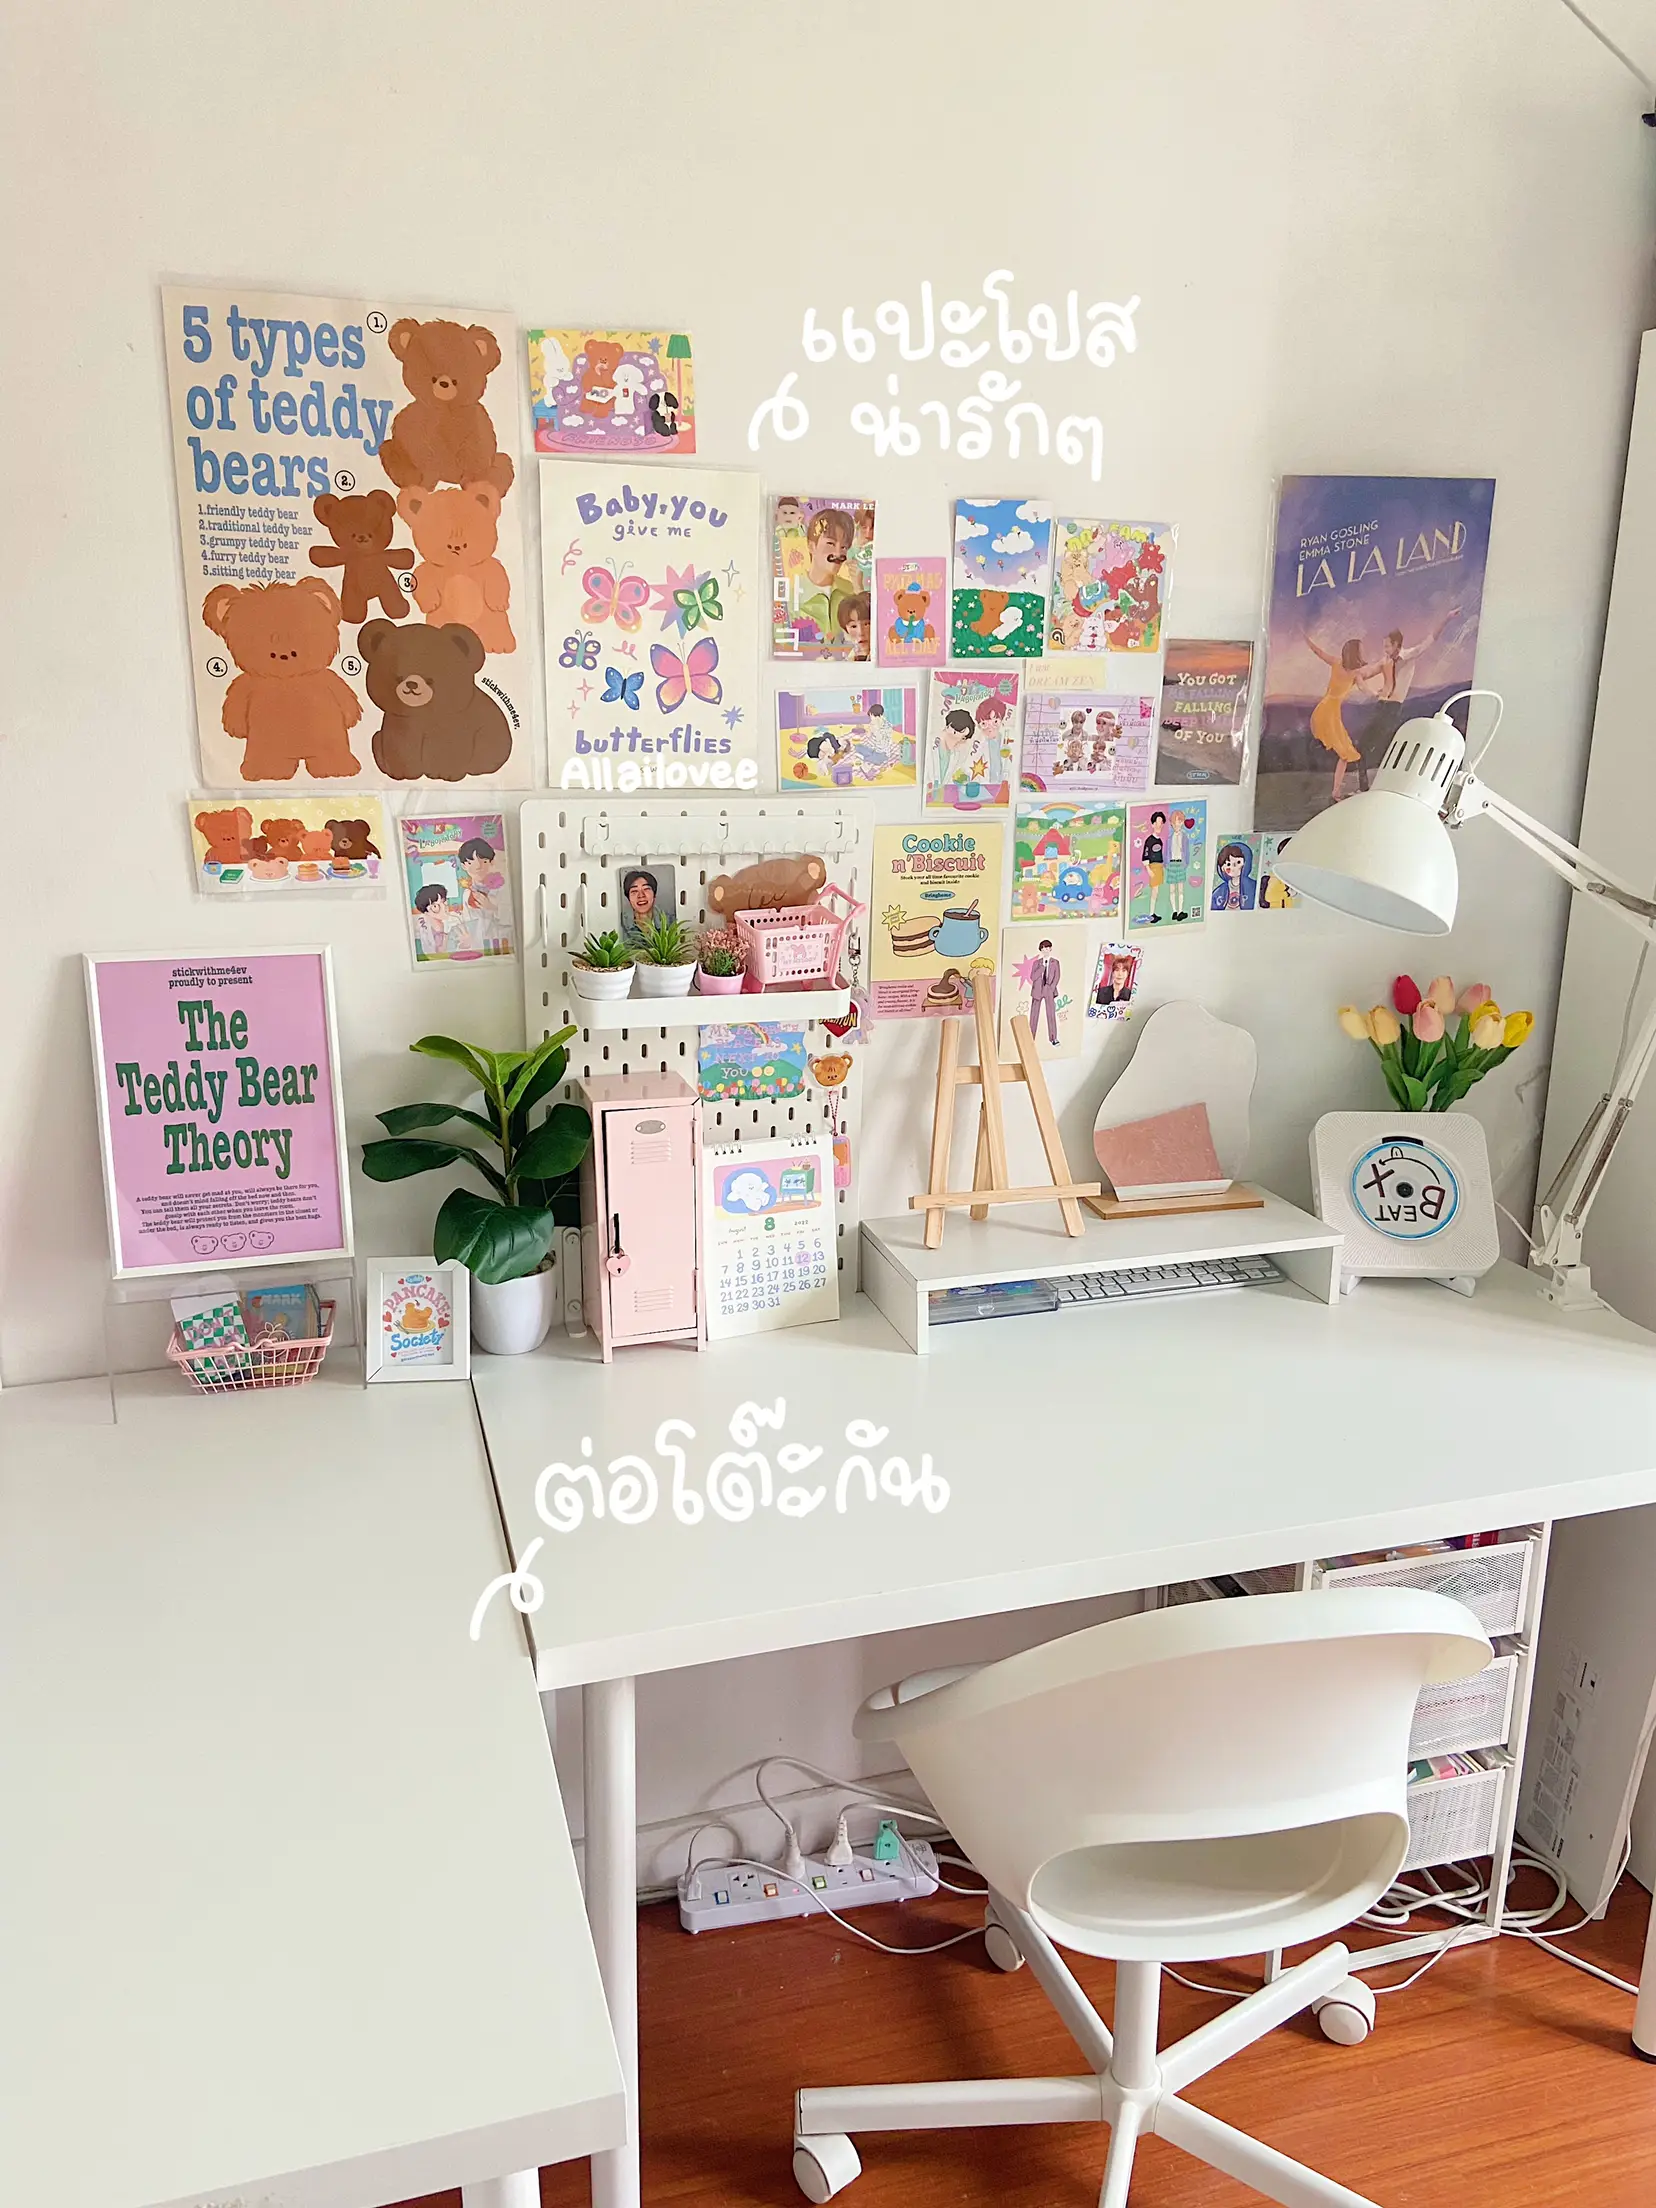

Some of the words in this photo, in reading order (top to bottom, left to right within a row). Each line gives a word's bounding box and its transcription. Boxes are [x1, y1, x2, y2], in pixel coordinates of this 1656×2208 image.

[183, 305, 212, 363] 5
[227, 305, 366, 378] types
[187, 374, 238, 431] of
[248, 378, 394, 456] teddy
[187, 436, 331, 498] bears
[248, 507, 276, 521] teddy
[277, 508, 299, 520] bear
[831, 502, 860, 510] MARK
[262, 522, 290, 537] teddy
[292, 524, 313, 536] bear
[1300, 532, 1328, 549] RYAN
[1330, 519, 1379, 540] GOSLING
[249, 537, 276, 552] teddy
[278, 538, 300, 550] bear
[1300, 547, 1331, 561] EMMA
[1333, 534, 1370, 552] STONE
[239, 552, 269, 566] teddy
[268, 553, 290, 564] bear
[1296, 558, 1337, 597] LA
[1347, 545, 1387, 584] LA
[1396, 521, 1467, 569] LAND
[246, 567, 273, 581] teddy
[275, 568, 297, 580] bear
[1177, 673, 1206, 686] YOU
[1209, 673, 1237, 685] GOT
[1174, 701, 1232, 714] FALLING
[1174, 730, 1193, 741] OF
[1197, 730, 1225, 744] YOU
[902, 833, 976, 853] Cookie
[169, 976, 204, 989] proudly
[207, 977, 216, 986] to
[218, 975, 253, 987] present
[172, 966, 247, 977] stickwithme4ev
[178, 1000, 249, 1051] The
[116, 1060, 228, 1123] Teddy
[235, 1057, 318, 1107] Bear
[164, 1122, 293, 1179] Theory
[764, 1217, 775, 1231] 8
[737, 1250, 743, 1259] 1
[752, 1248, 759, 1257] 2
[768, 1245, 775, 1256] 3
[783, 1243, 791, 1252] 4
[798, 1241, 805, 1250] 5
[814, 1238, 821, 1248] 6
[721, 1265, 728, 1275] 7
[736, 1263, 744, 1273] 8
[752, 1260, 760, 1270] 9
[766, 1257, 779, 1268] 10
[782, 1256, 793, 1266] 11
[796, 1254, 808, 1263] 12
[812, 1251, 824, 1261] 13
[720, 1278, 731, 1288] 14
[735, 1276, 747, 1287] 15
[751, 1273, 764, 1284] 16
[767, 1271, 779, 1282] 17
[782, 1269, 794, 1280] 18
[798, 1266, 810, 1277] 19
[813, 1265, 826, 1275] 20
[383, 1284, 451, 1315] PANCAKE
[720, 1292, 733, 1302] 21
[735, 1289, 749, 1301] 22
[751, 1287, 764, 1298] 23
[767, 1284, 780, 1295] 24
[783, 1282, 796, 1292] 25
[799, 1280, 811, 1290] 26
[814, 1278, 826, 1288] 27
[721, 1305, 734, 1315] 28
[736, 1302, 749, 1313] 29
[752, 1300, 765, 1310] 30
[768, 1297, 780, 1307] 31
[390, 1328, 445, 1352] Society
